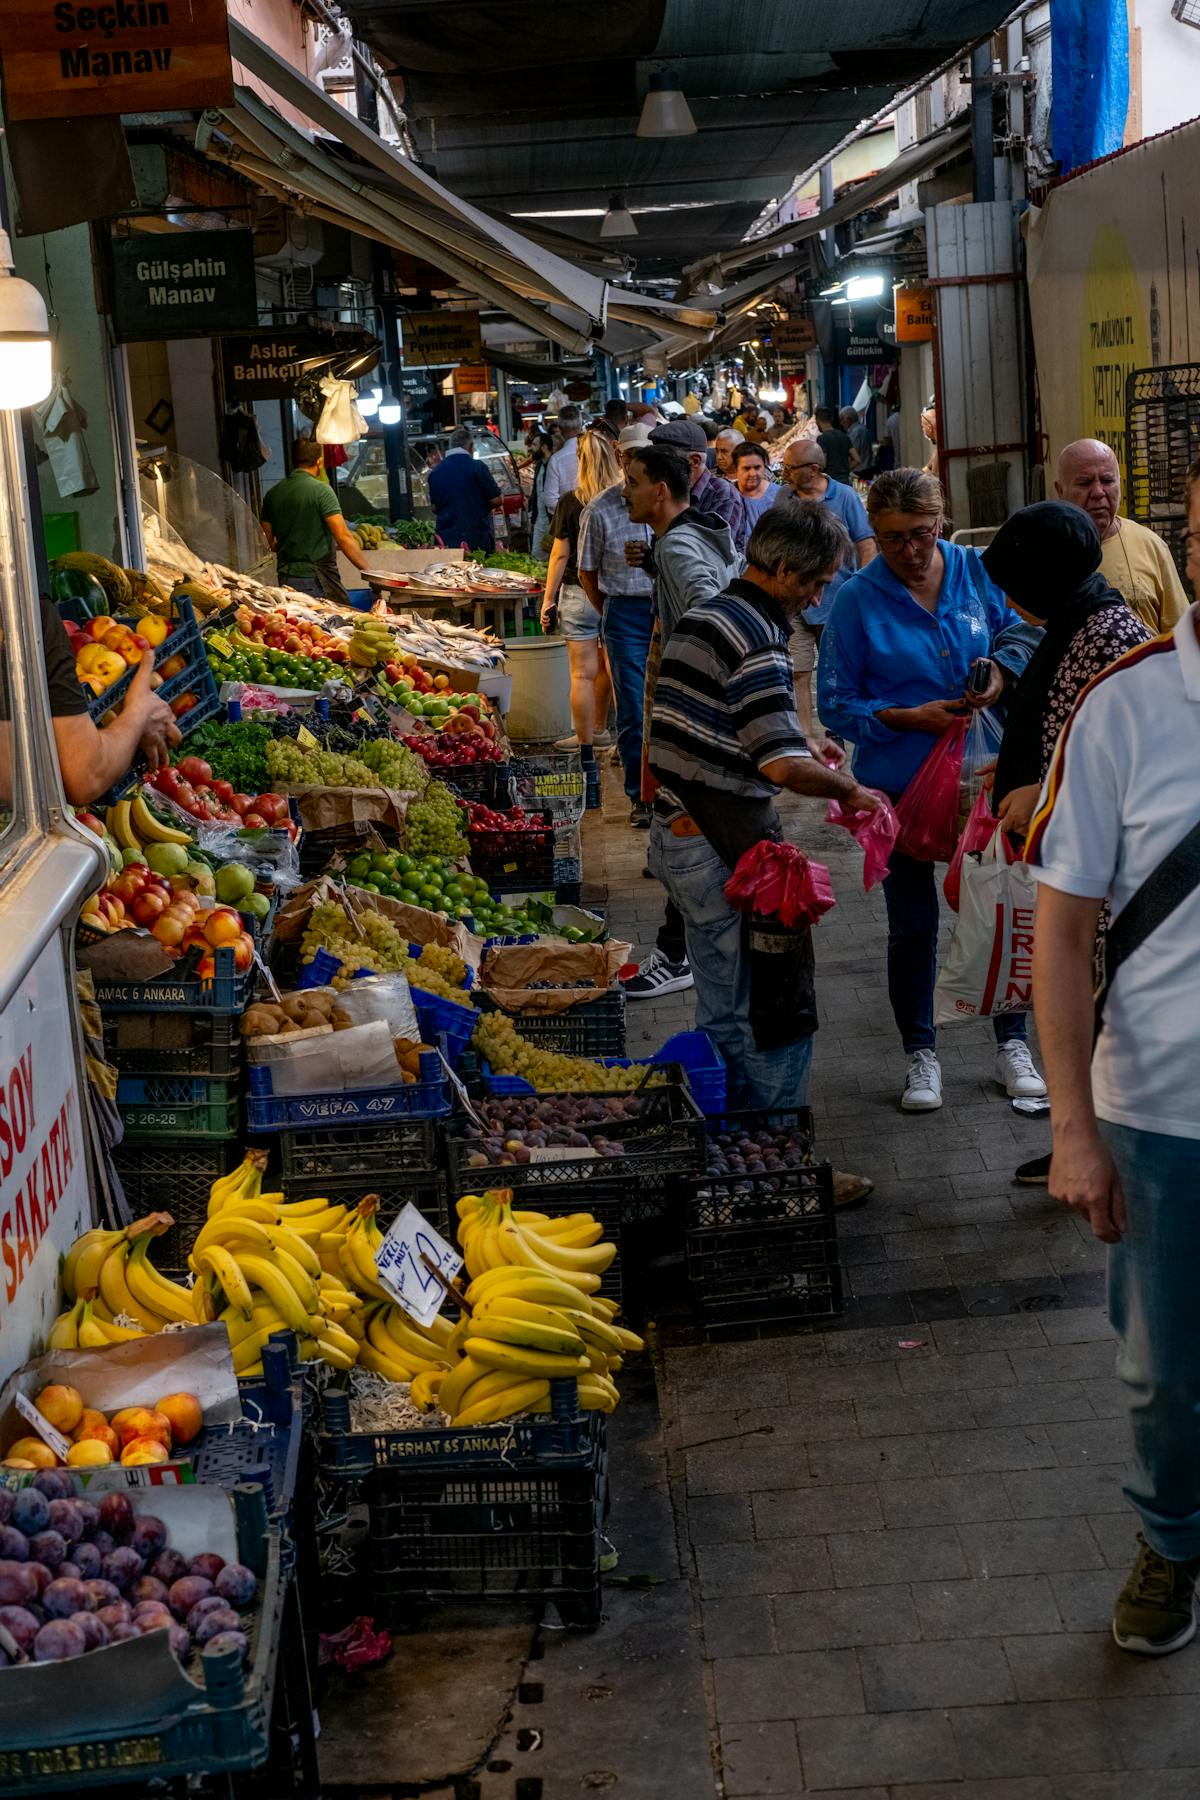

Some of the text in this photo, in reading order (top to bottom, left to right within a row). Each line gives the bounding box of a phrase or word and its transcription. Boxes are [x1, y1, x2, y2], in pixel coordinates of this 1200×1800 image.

[54, 0, 169, 38] Seçkin
[60, 47, 172, 78] Manav
[137, 258, 226, 283] Gülşahin
[148, 287, 216, 305] Manav
[233, 363, 301, 382] Balıkçıl
[1092, 362, 1136, 417] YATIRI
[1005, 908, 1034, 1001] EREN
[95, 987, 186, 1001] AMAC 6 ANKARA
[0, 1043, 36, 1188] SOY
[300, 1097, 396, 1117] VEFA 47
[140, 1113, 177, 1125] 26-28
[390, 1439, 441, 1457] FERHAT
[462, 1436, 518, 1453] ANKARA
